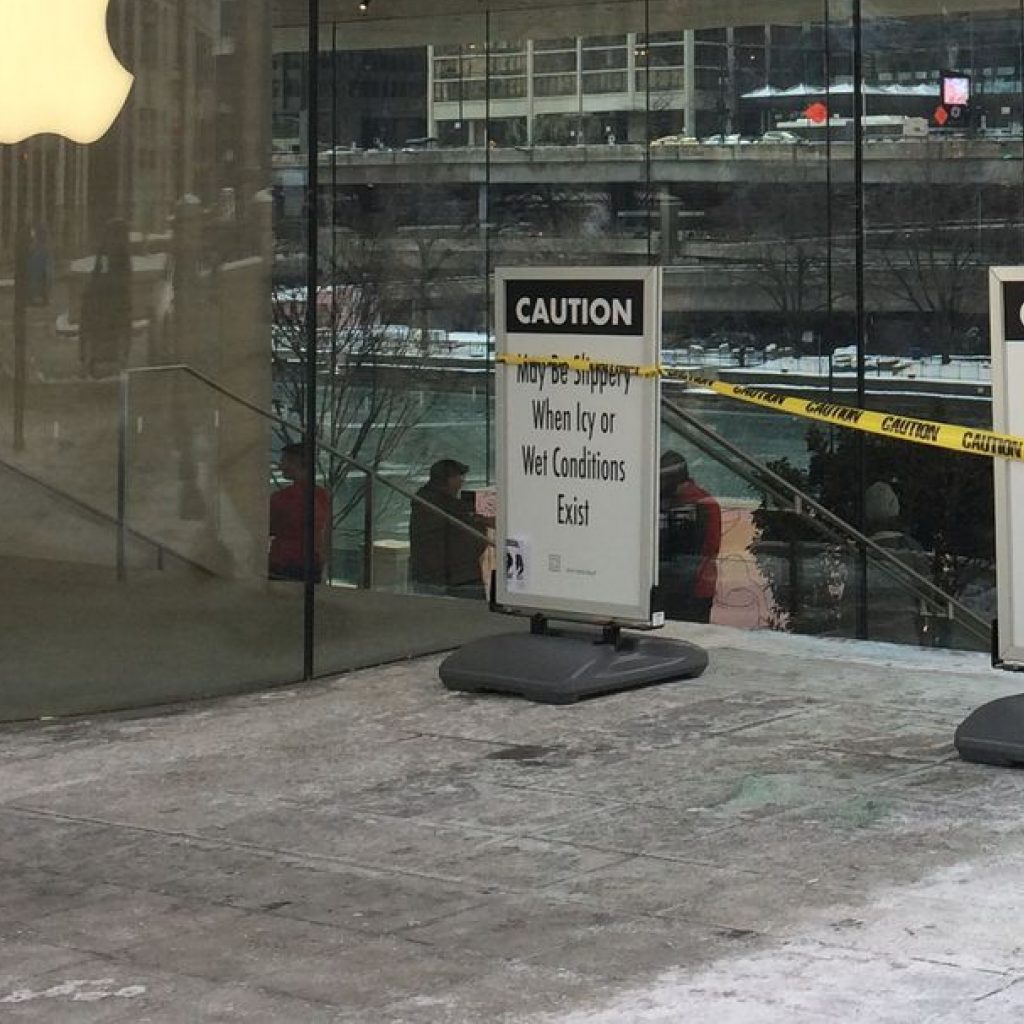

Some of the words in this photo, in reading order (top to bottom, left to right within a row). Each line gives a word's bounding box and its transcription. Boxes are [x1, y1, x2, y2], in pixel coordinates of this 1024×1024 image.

[515, 297, 633, 326] CAUTION
[531, 397, 571, 431] When
[576, 401, 597, 441] Icy
[601, 412, 616, 434] or
[804, 400, 864, 424] CAUTION
[881, 416, 941, 442] CAUTION
[961, 430, 1024, 459] CAUTION
[521, 445, 547, 476] Wet
[552, 446, 626, 482] Conditions
[556, 493, 590, 526] Exist
